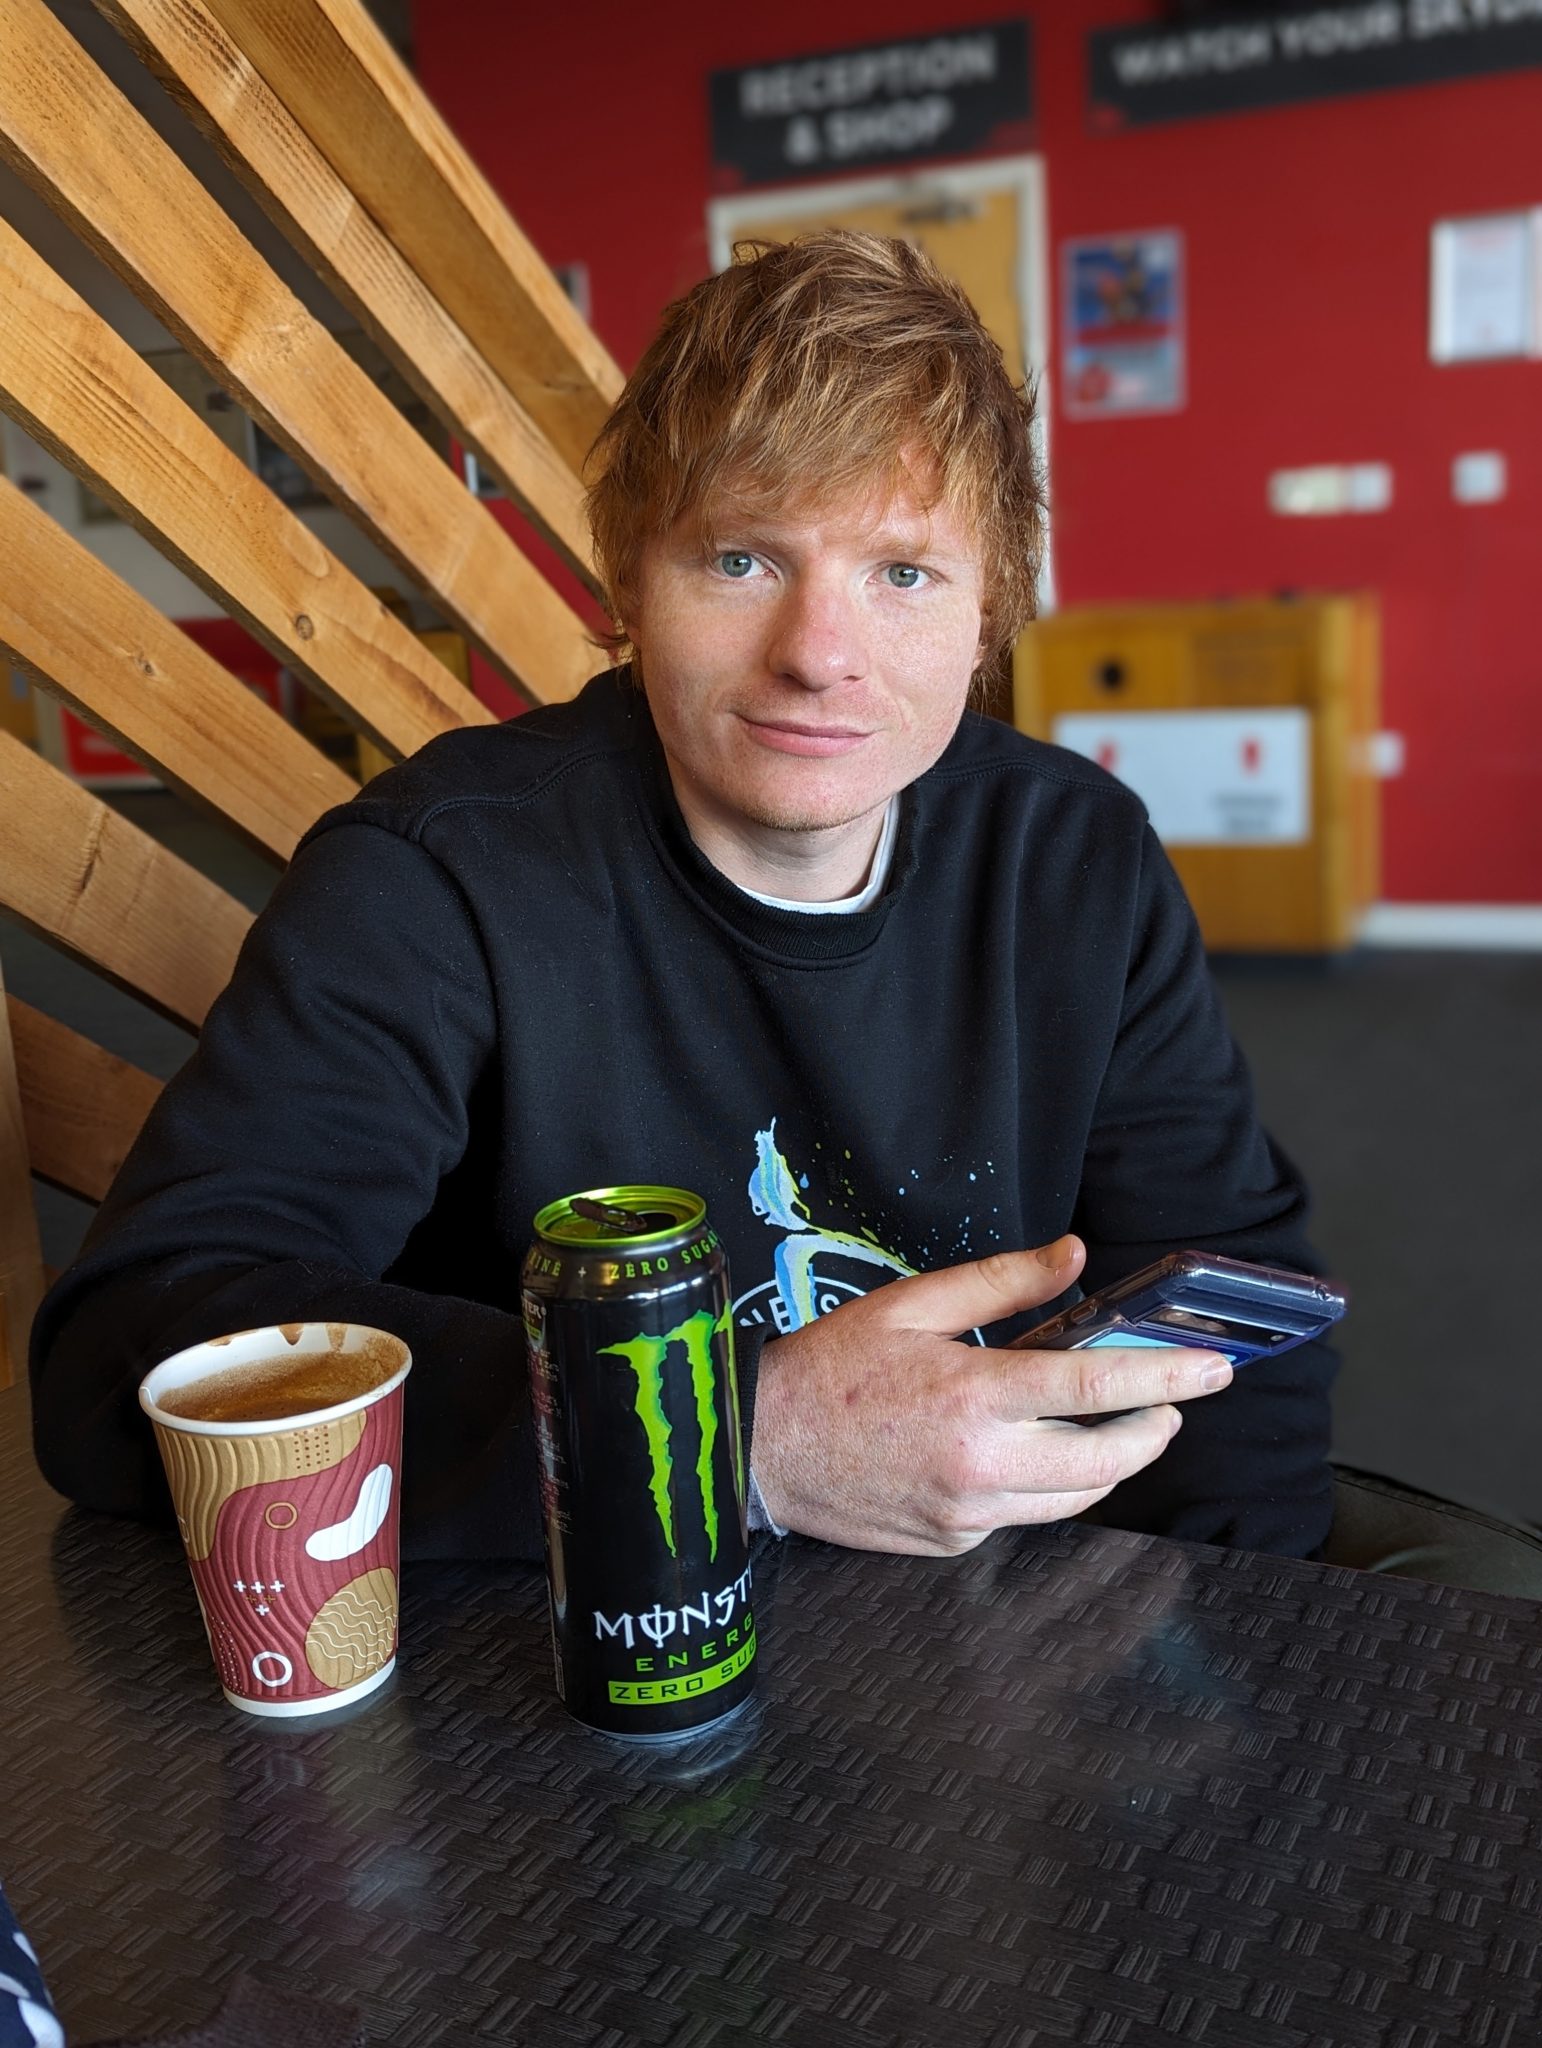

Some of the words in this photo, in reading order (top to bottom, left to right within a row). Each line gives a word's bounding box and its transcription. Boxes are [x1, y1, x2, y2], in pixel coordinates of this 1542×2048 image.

[1115, 25, 1271, 86] WATCH
[1277, 3, 1400, 58] YOUR
[741, 35, 996, 115] RECEPTION
[827, 96, 953, 156] SHOP
[610, 1256, 669, 1280] ZERO
[592, 1558, 752, 1649] MONST
[636, 1612, 752, 1672] ENERG
[614, 1677, 704, 1700] ZERO
